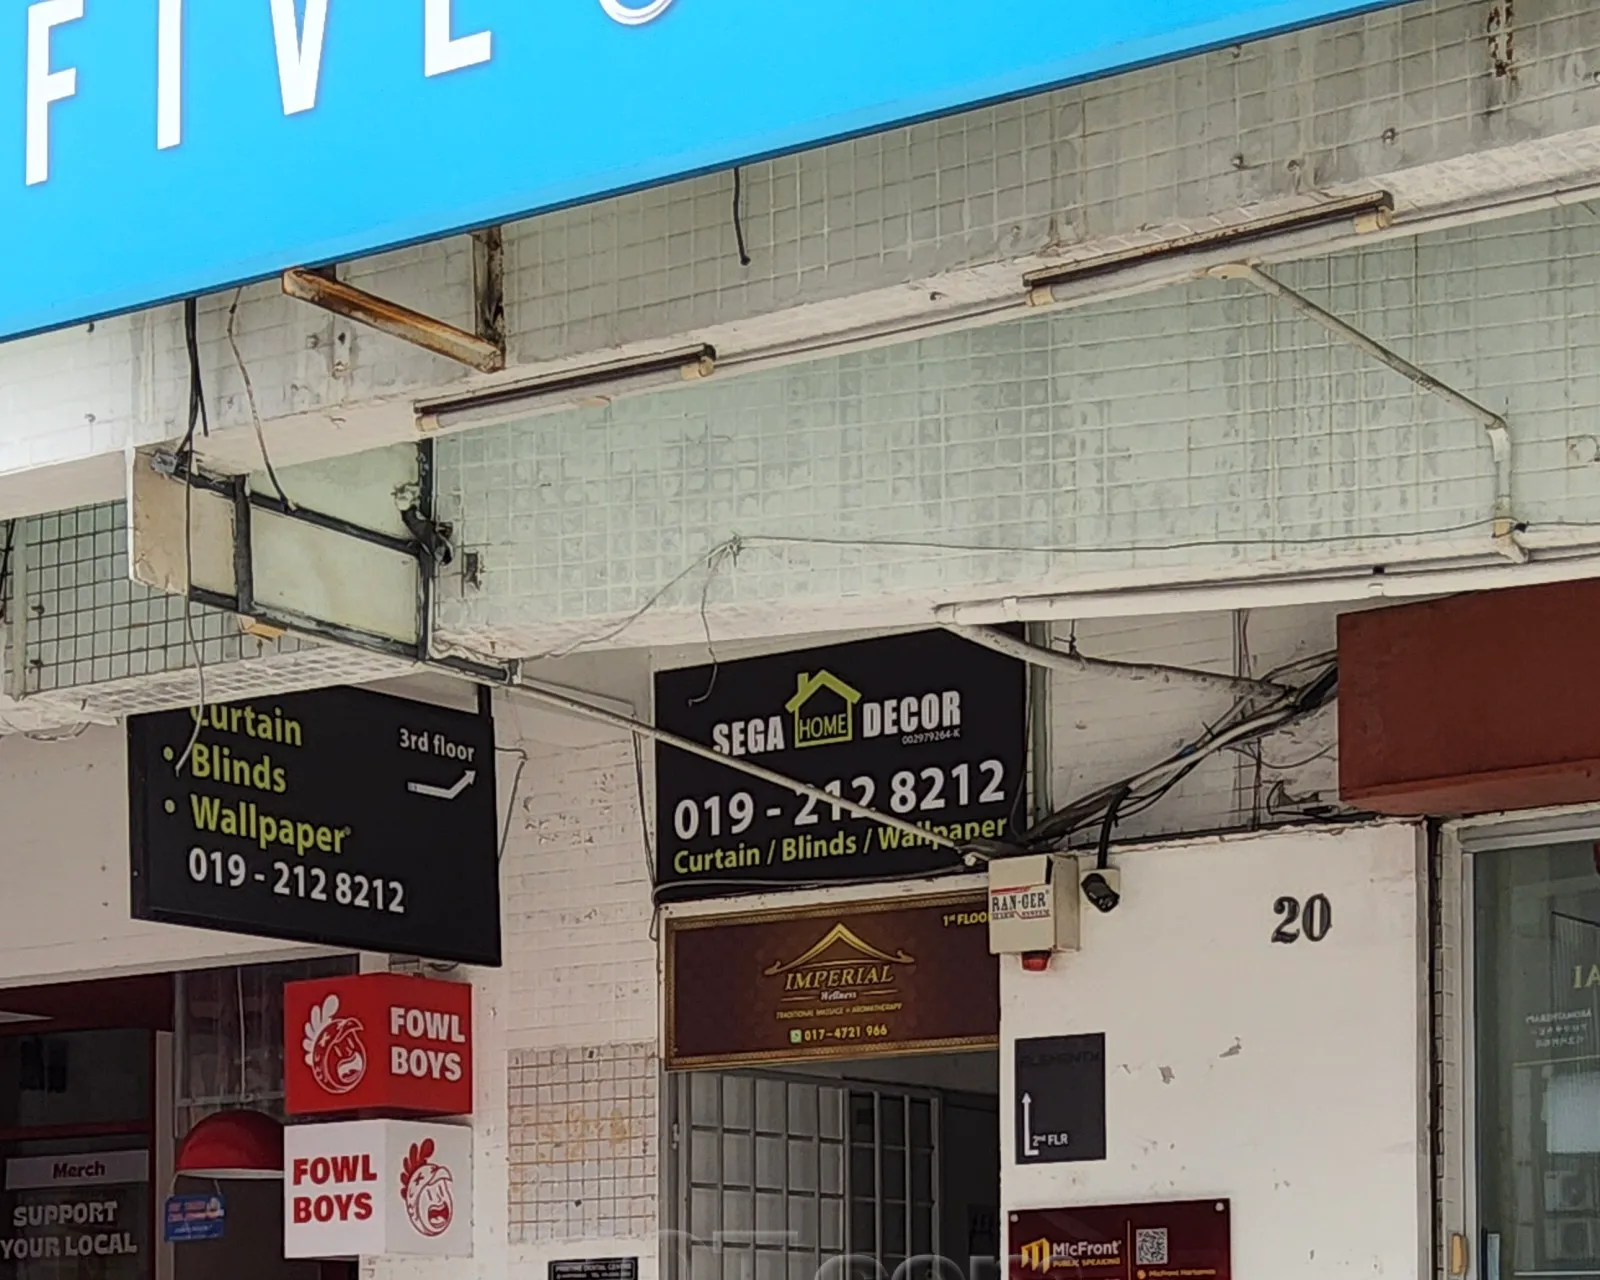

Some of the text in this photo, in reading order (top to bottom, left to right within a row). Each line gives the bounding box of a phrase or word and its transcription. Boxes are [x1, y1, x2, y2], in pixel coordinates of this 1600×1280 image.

[712, 690, 961, 757] SEGA HOME DECOR
[400, 728, 475, 764] 3rd floor
[191, 743, 287, 794] Blinds
[674, 792, 754, 841] 019
[793, 775, 876, 827] 212
[889, 759, 1005, 814] 8212
[190, 794, 347, 856] Wallpaper
[673, 843, 760, 875] Curtain
[782, 831, 857, 862] Blinds
[189, 847, 246, 888] 019
[273, 861, 327, 902] 212
[335, 872, 406, 914] 8212
[957, 911, 993, 926] FLOO
[1271, 893, 1333, 944] 20
[784, 965, 895, 991] IMPERIAL
[820, 990, 857, 1001] Wellness
[390, 1006, 465, 1043] FOWL
[866, 1024, 888, 1037] 966
[391, 1046, 462, 1081] BOYS
[1048, 1133, 1069, 1146] FLR
[53, 1160, 105, 1179] Merch
[293, 1154, 377, 1186] FOWL
[13, 1201, 118, 1227] SUPPORT
[293, 1192, 373, 1224] BOYS
[0, 1232, 138, 1260] YOUR LOCAL
[1052, 1240, 1119, 1257] MicFront
